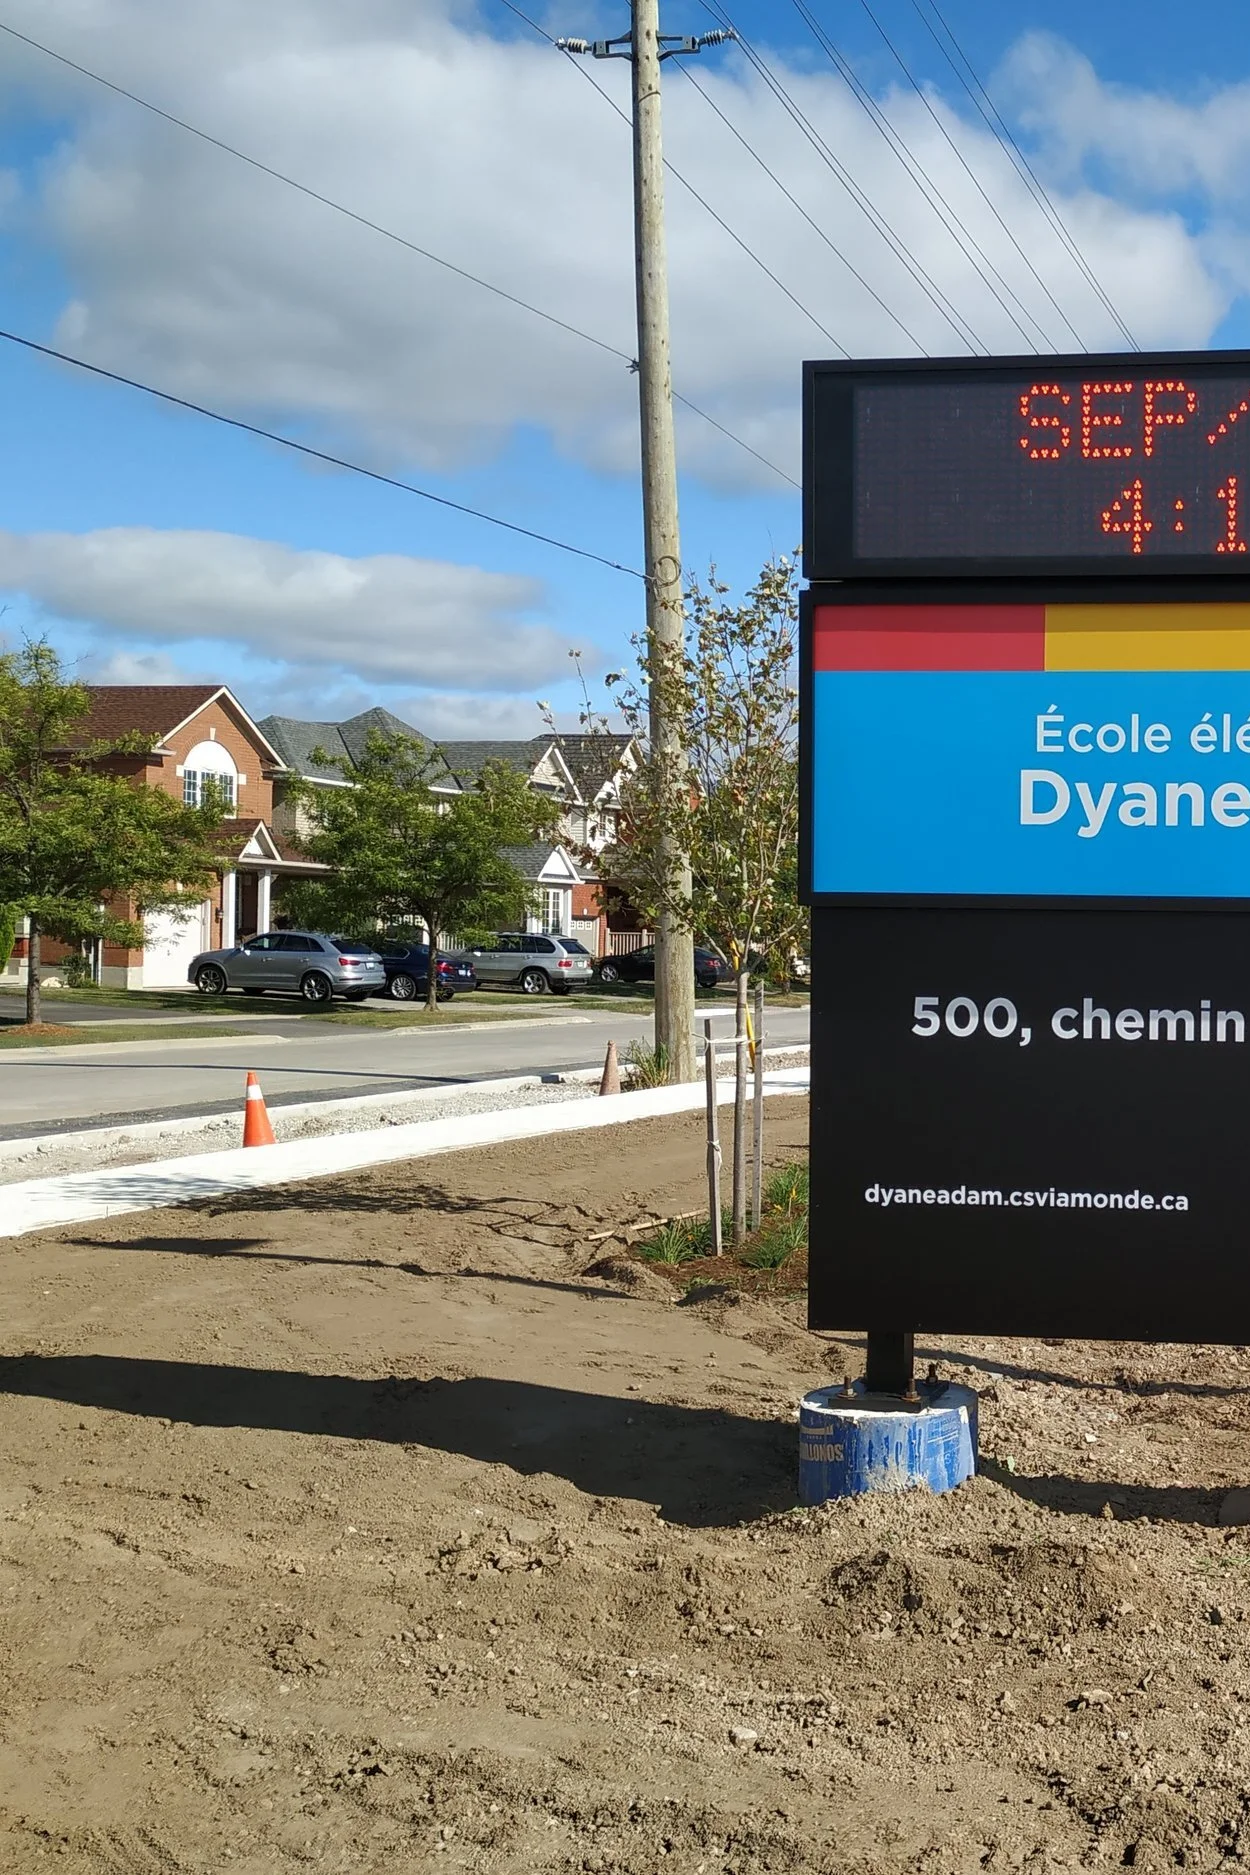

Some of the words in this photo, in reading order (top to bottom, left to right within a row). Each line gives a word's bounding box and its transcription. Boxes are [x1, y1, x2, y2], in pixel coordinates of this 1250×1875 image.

[1036, 705, 1171, 754] École
[911, 996, 1032, 1047] 500,
[1051, 998, 1245, 1043] chemin
[864, 1183, 1189, 1211] dyaneadam.csviamonde.ca
